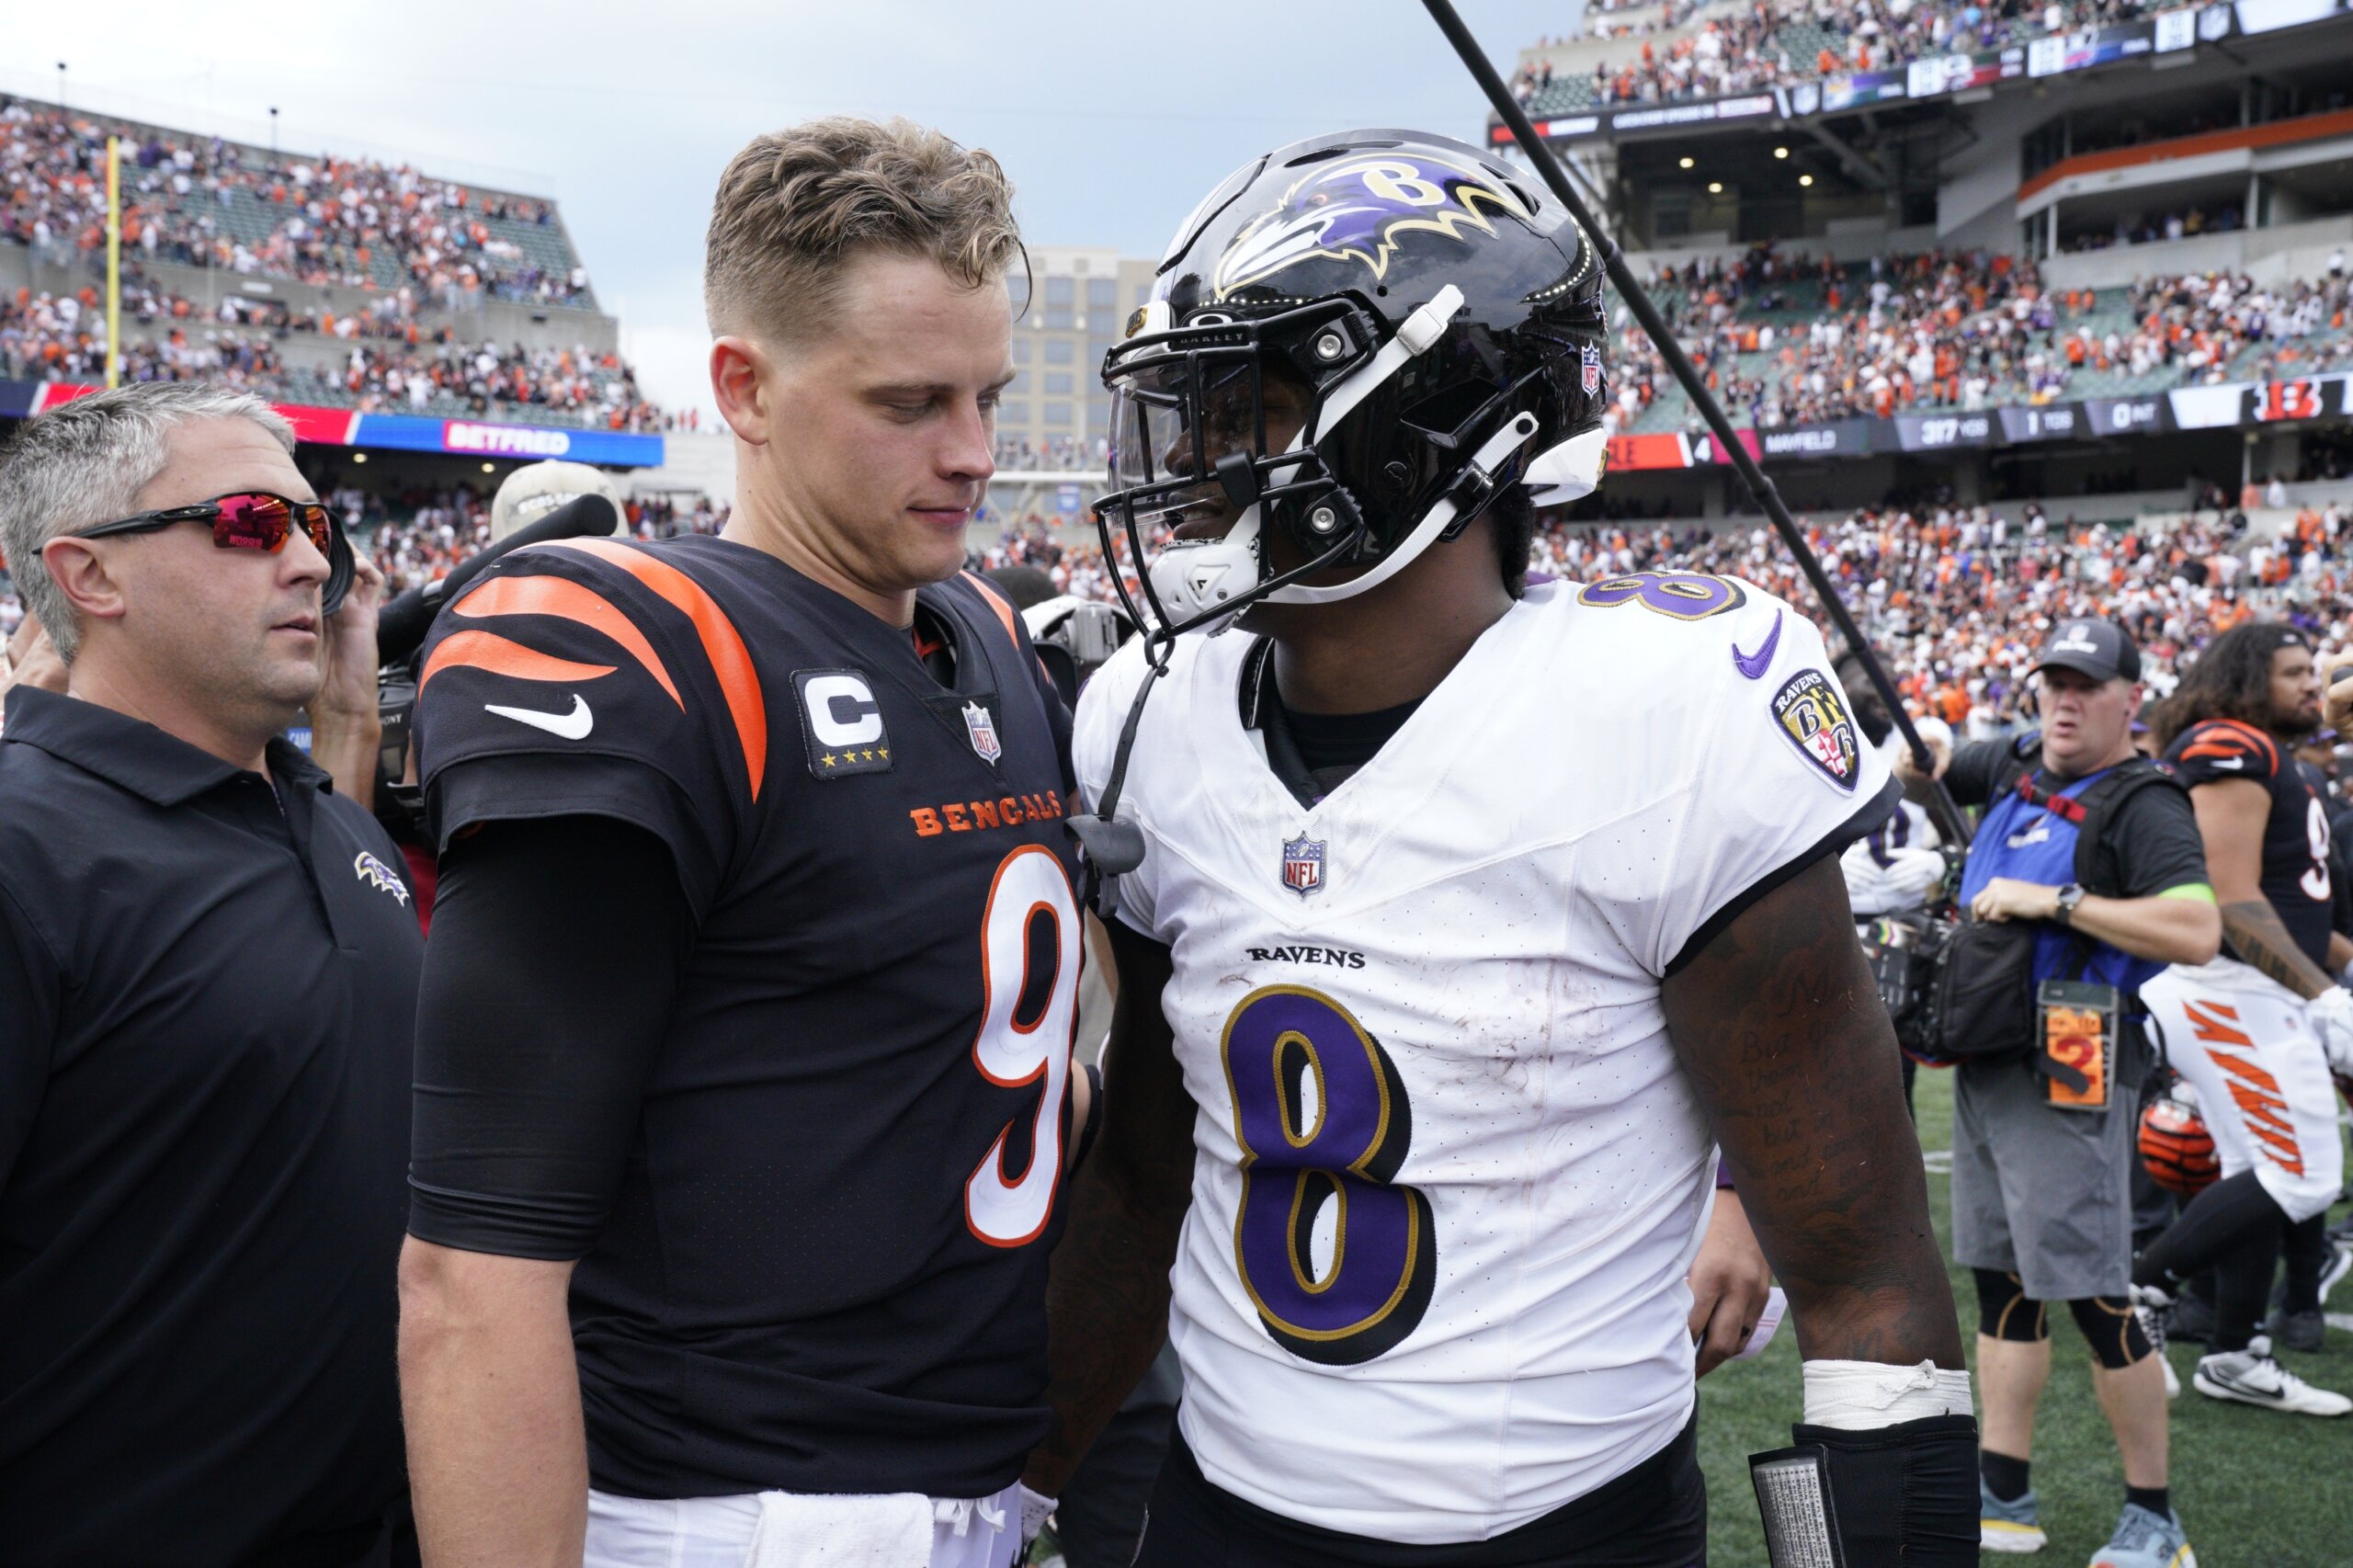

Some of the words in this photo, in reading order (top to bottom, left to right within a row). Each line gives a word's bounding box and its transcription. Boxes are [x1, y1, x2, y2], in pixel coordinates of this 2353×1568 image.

[1585, 367, 1598, 388] NFL
[448, 423, 570, 456] BETFRED
[1765, 429, 1836, 453] MAYFIELD
[1775, 672, 1823, 713] RAVENS
[380, 713, 404, 727] ONY
[804, 676, 883, 747] C
[973, 728, 997, 752] NFL
[910, 790, 1063, 837] BENGALS
[1286, 861, 1317, 888] NFL
[1245, 946, 1366, 970] RAVENS
[964, 843, 1083, 1248] 9
[1221, 983, 1438, 1367] 8
